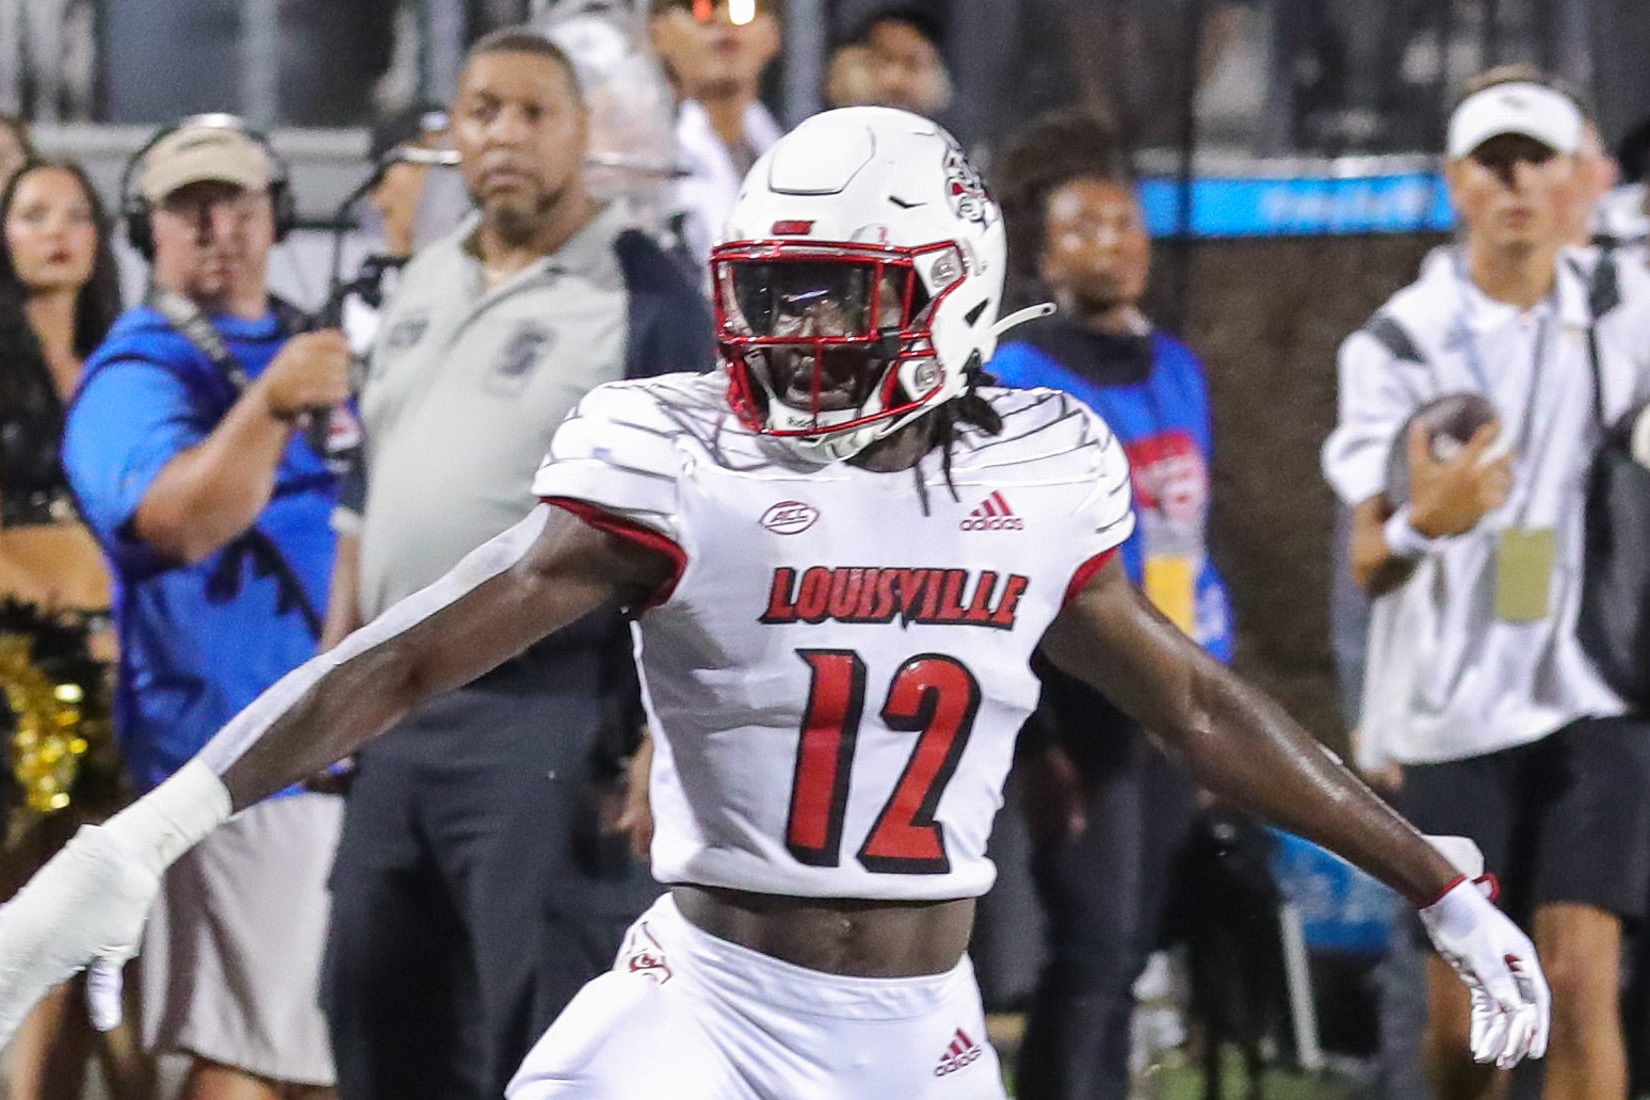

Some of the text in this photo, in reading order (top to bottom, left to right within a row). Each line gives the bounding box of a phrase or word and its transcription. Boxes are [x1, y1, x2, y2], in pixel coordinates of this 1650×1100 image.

[770, 507, 810, 522] ACC
[960, 518, 1024, 531] adidas
[757, 566, 1029, 631] LOUISVILLE
[786, 648, 981, 874] 12
[933, 1045, 982, 1077] adidas
